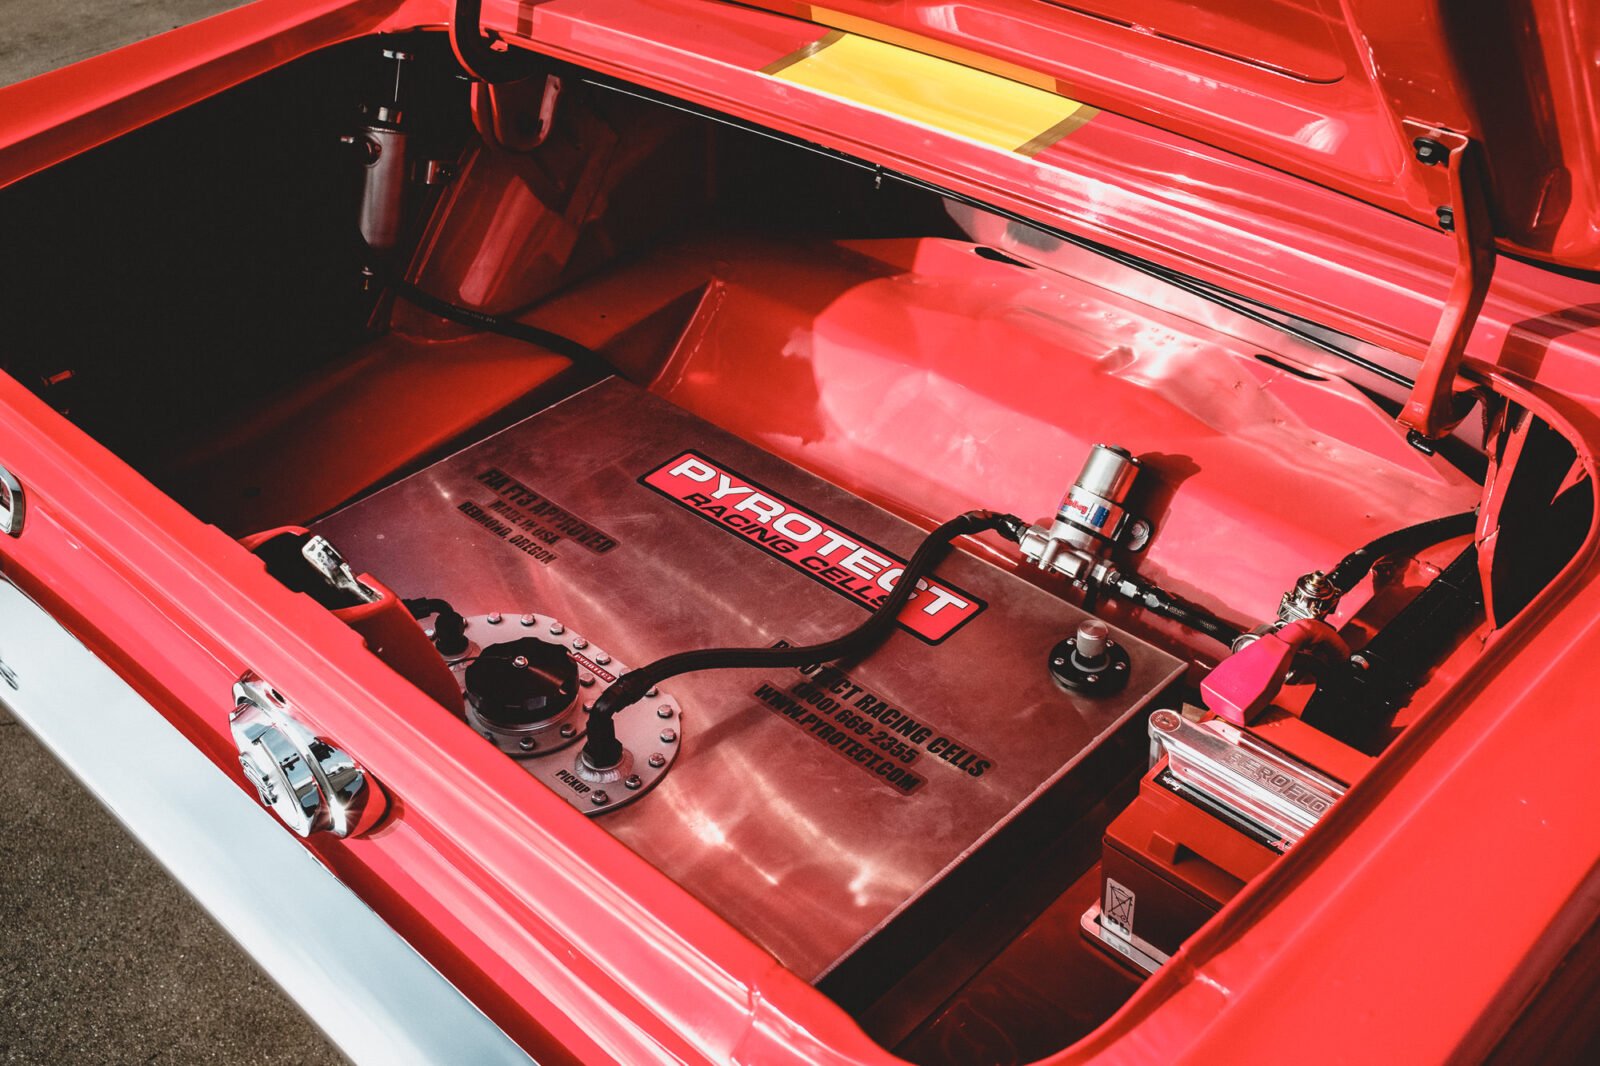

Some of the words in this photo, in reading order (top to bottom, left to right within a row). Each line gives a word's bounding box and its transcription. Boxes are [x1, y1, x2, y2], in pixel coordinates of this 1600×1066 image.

[488, 500, 522, 524] MADE
[519, 520, 538, 532] IN
[532, 527, 561, 545] USA
[501, 483, 539, 507] FT3
[528, 500, 617, 553] APPROVED
[668, 458, 969, 616] PYROTECT
[682, 493, 799, 554] RACING
[509, 534, 557, 564] OREGON
[753, 683, 922, 791] WWW.PYROTECT.COM
[834, 709, 920, 764] 669-2355
[854, 693, 934, 745] RACING
[926, 736, 991, 777] CELLS
[556, 769, 591, 795] PICKUP
